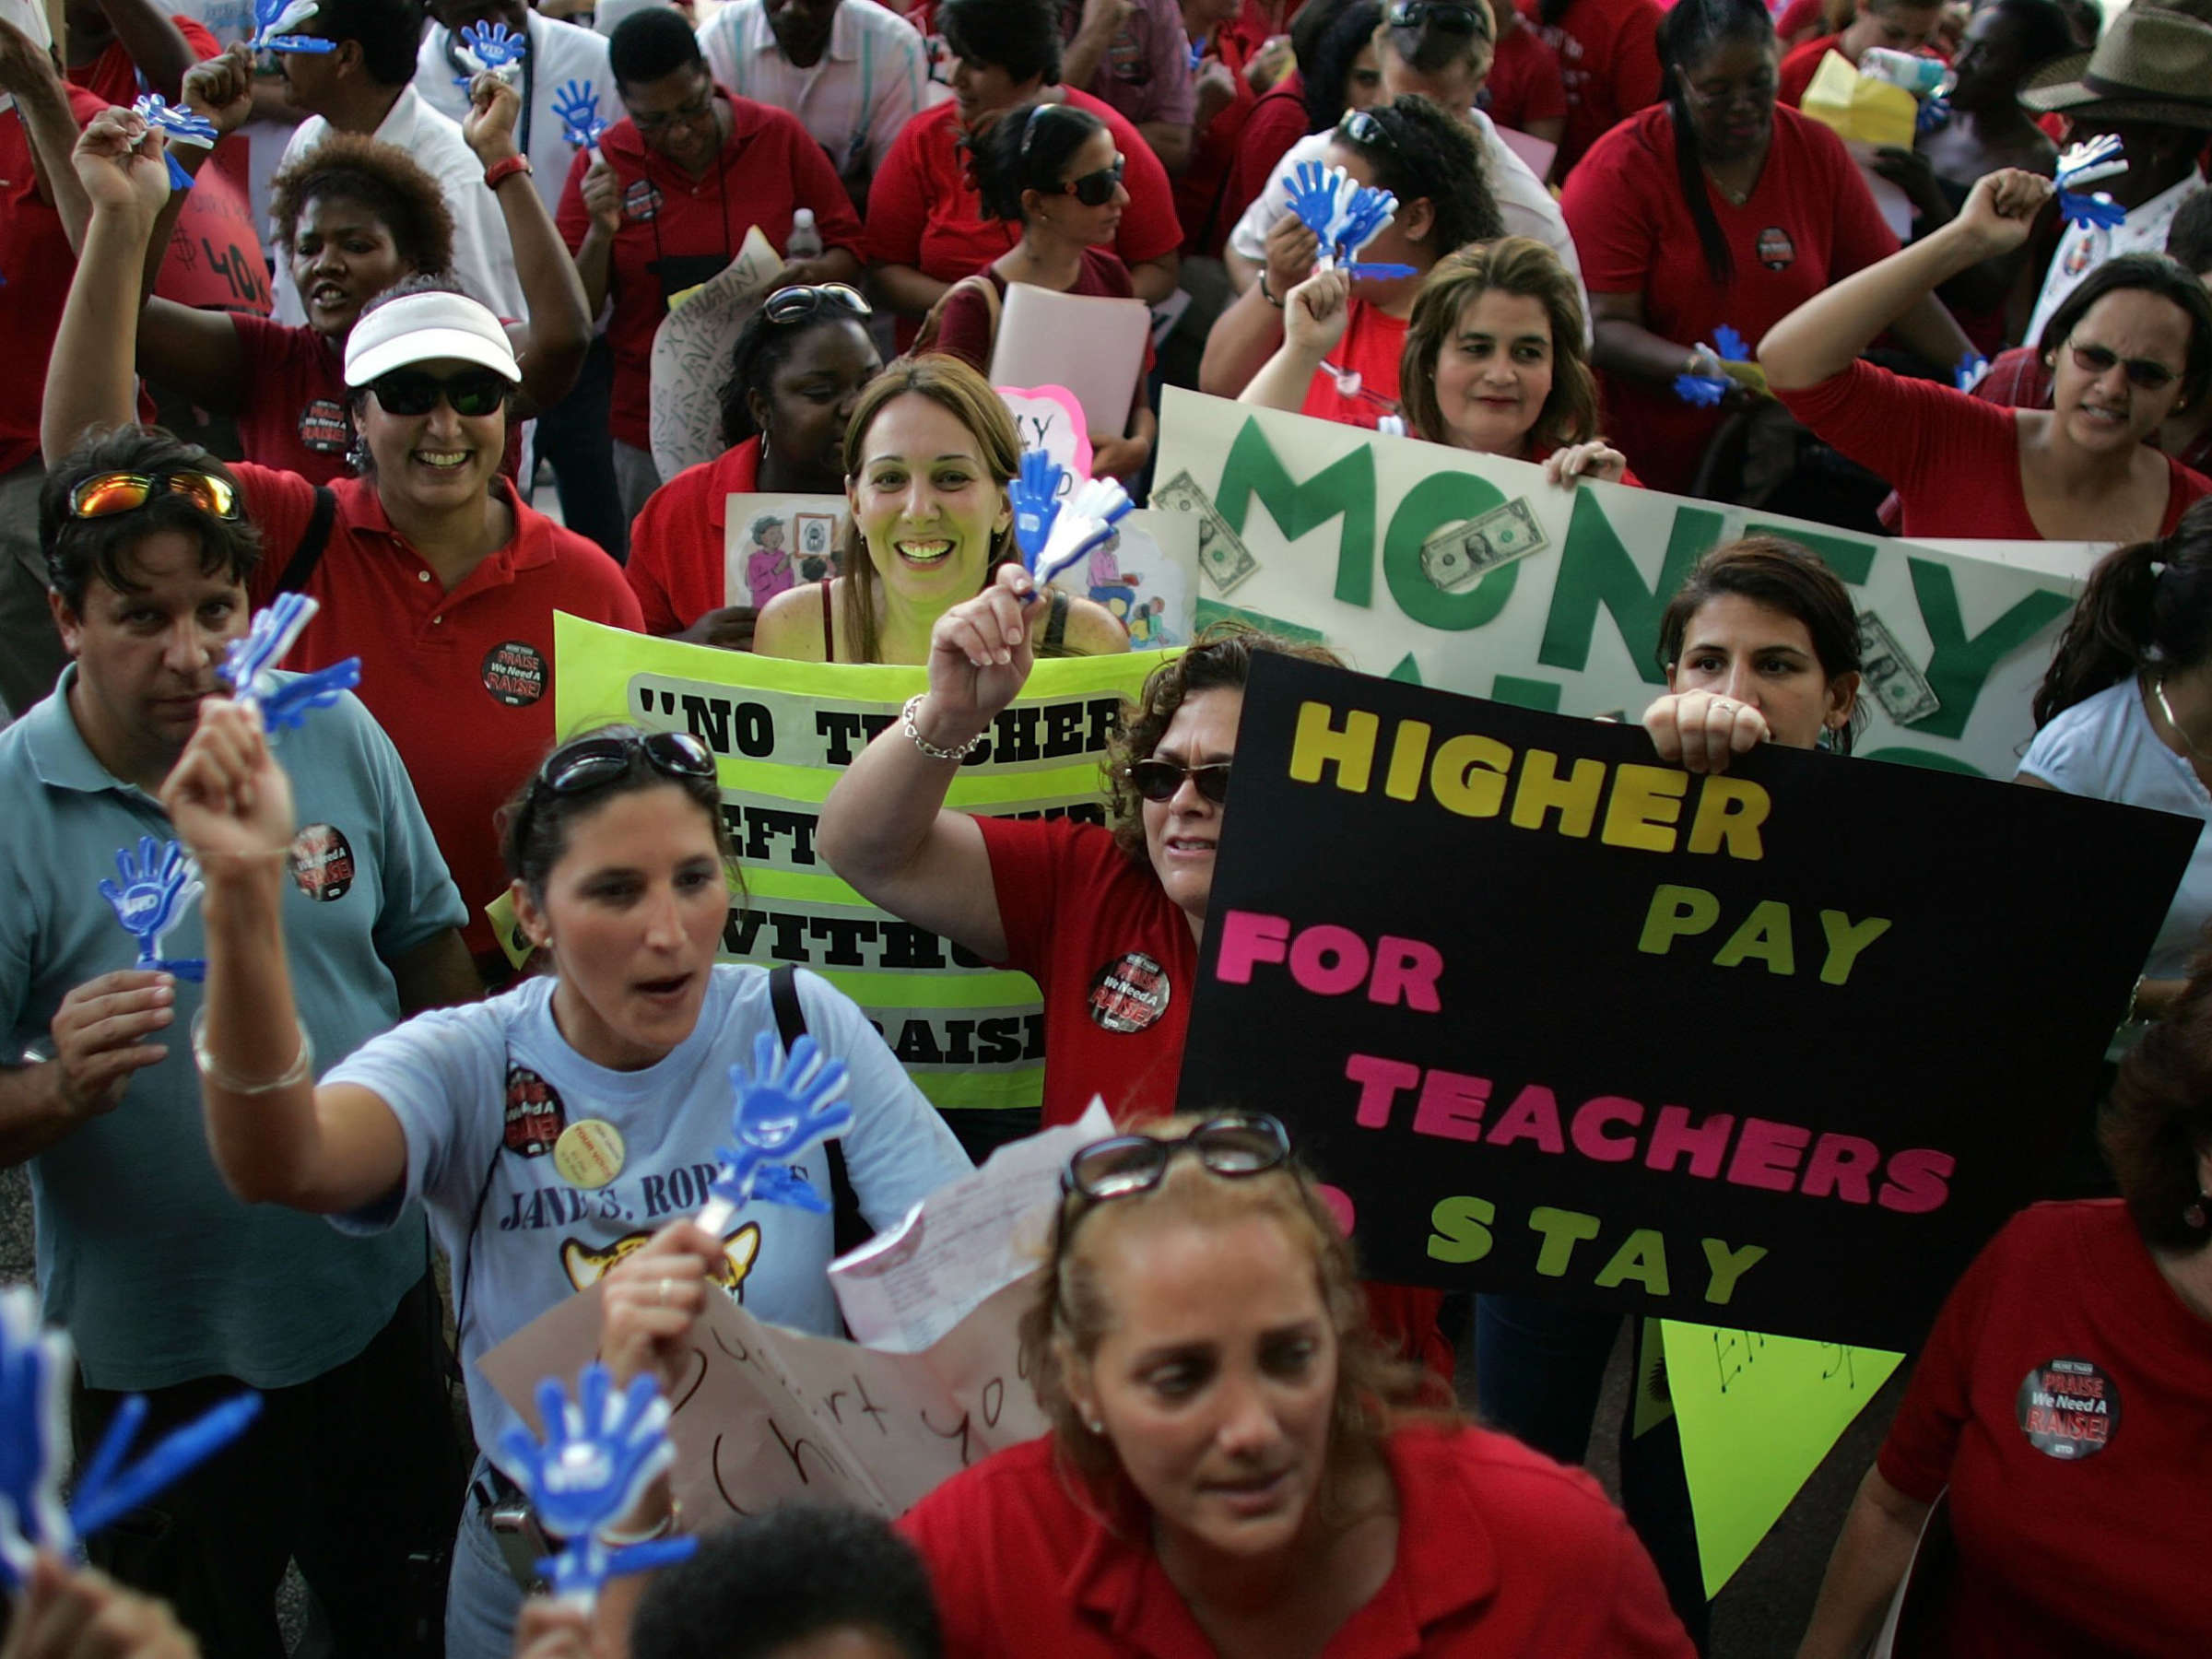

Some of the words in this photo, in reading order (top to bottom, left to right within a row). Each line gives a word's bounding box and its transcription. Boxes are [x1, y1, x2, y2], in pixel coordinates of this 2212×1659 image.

[1213, 414, 2074, 741] MONY
[491, 662, 507, 675] We
[507, 666, 534, 679] Need
[533, 672, 541, 681] A
[499, 650, 539, 671] PRAISE
[1290, 700, 1771, 861] HIGHER
[1638, 883, 1893, 985] PAY
[1216, 910, 1444, 1013] FOR
[1103, 975, 1119, 989] We
[1118, 981, 1149, 1003] Need
[1147, 995, 1158, 1006] A
[1345, 1053, 1957, 1214] TEACHERS
[500, 1185, 590, 1231] JANE
[1427, 1194, 1769, 1304] STAY
[2031, 1391, 2055, 1407] We
[2055, 1394, 2095, 1413] Need
[2094, 1400, 2108, 1413] A
[2042, 1371, 2105, 1398] PRAISE
[2026, 1407, 2109, 1444] RAISE!
